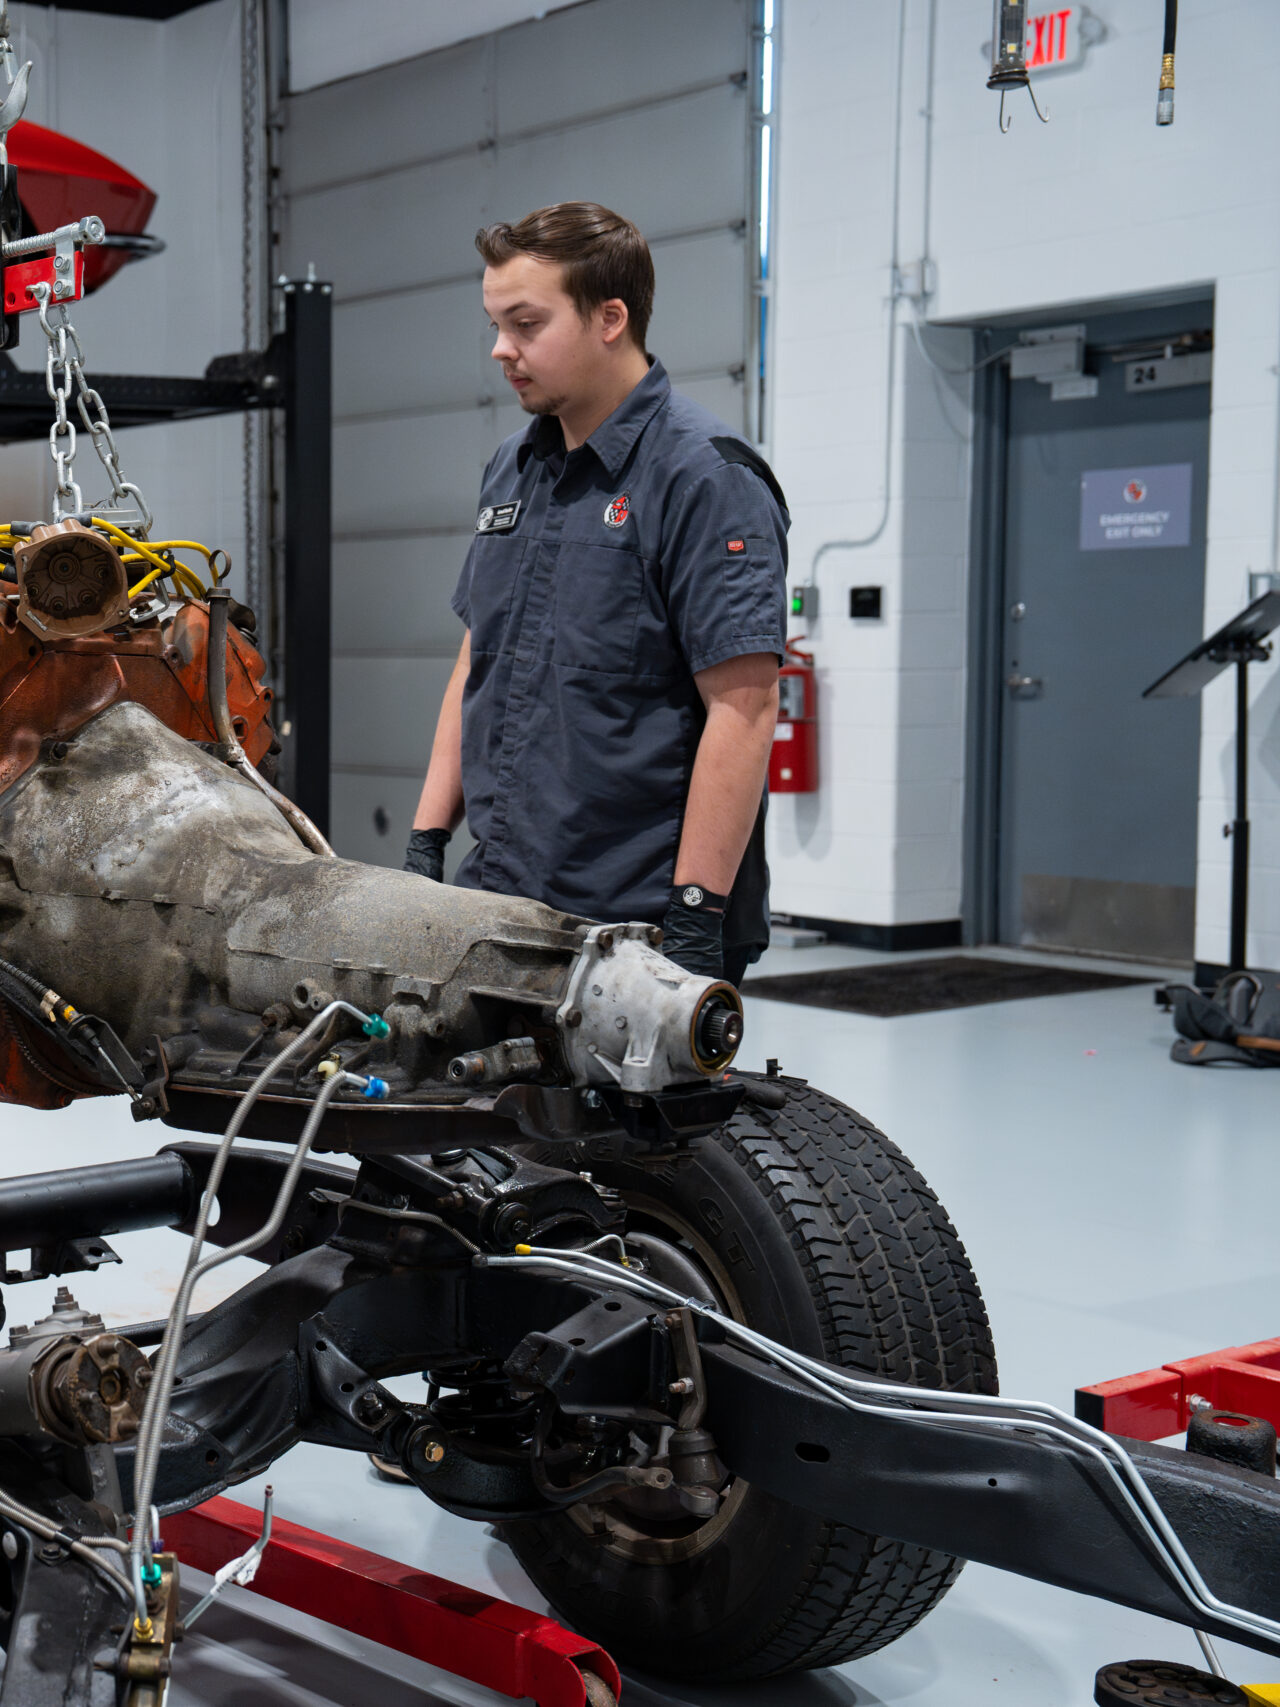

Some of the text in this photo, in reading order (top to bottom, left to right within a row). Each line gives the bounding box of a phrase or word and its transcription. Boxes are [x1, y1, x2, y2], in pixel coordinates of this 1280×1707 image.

[1134, 365, 1156, 384] 24
[1099, 511, 1169, 527] EMERGENCY
[1105, 524, 1163, 540] EXIT ONLY
